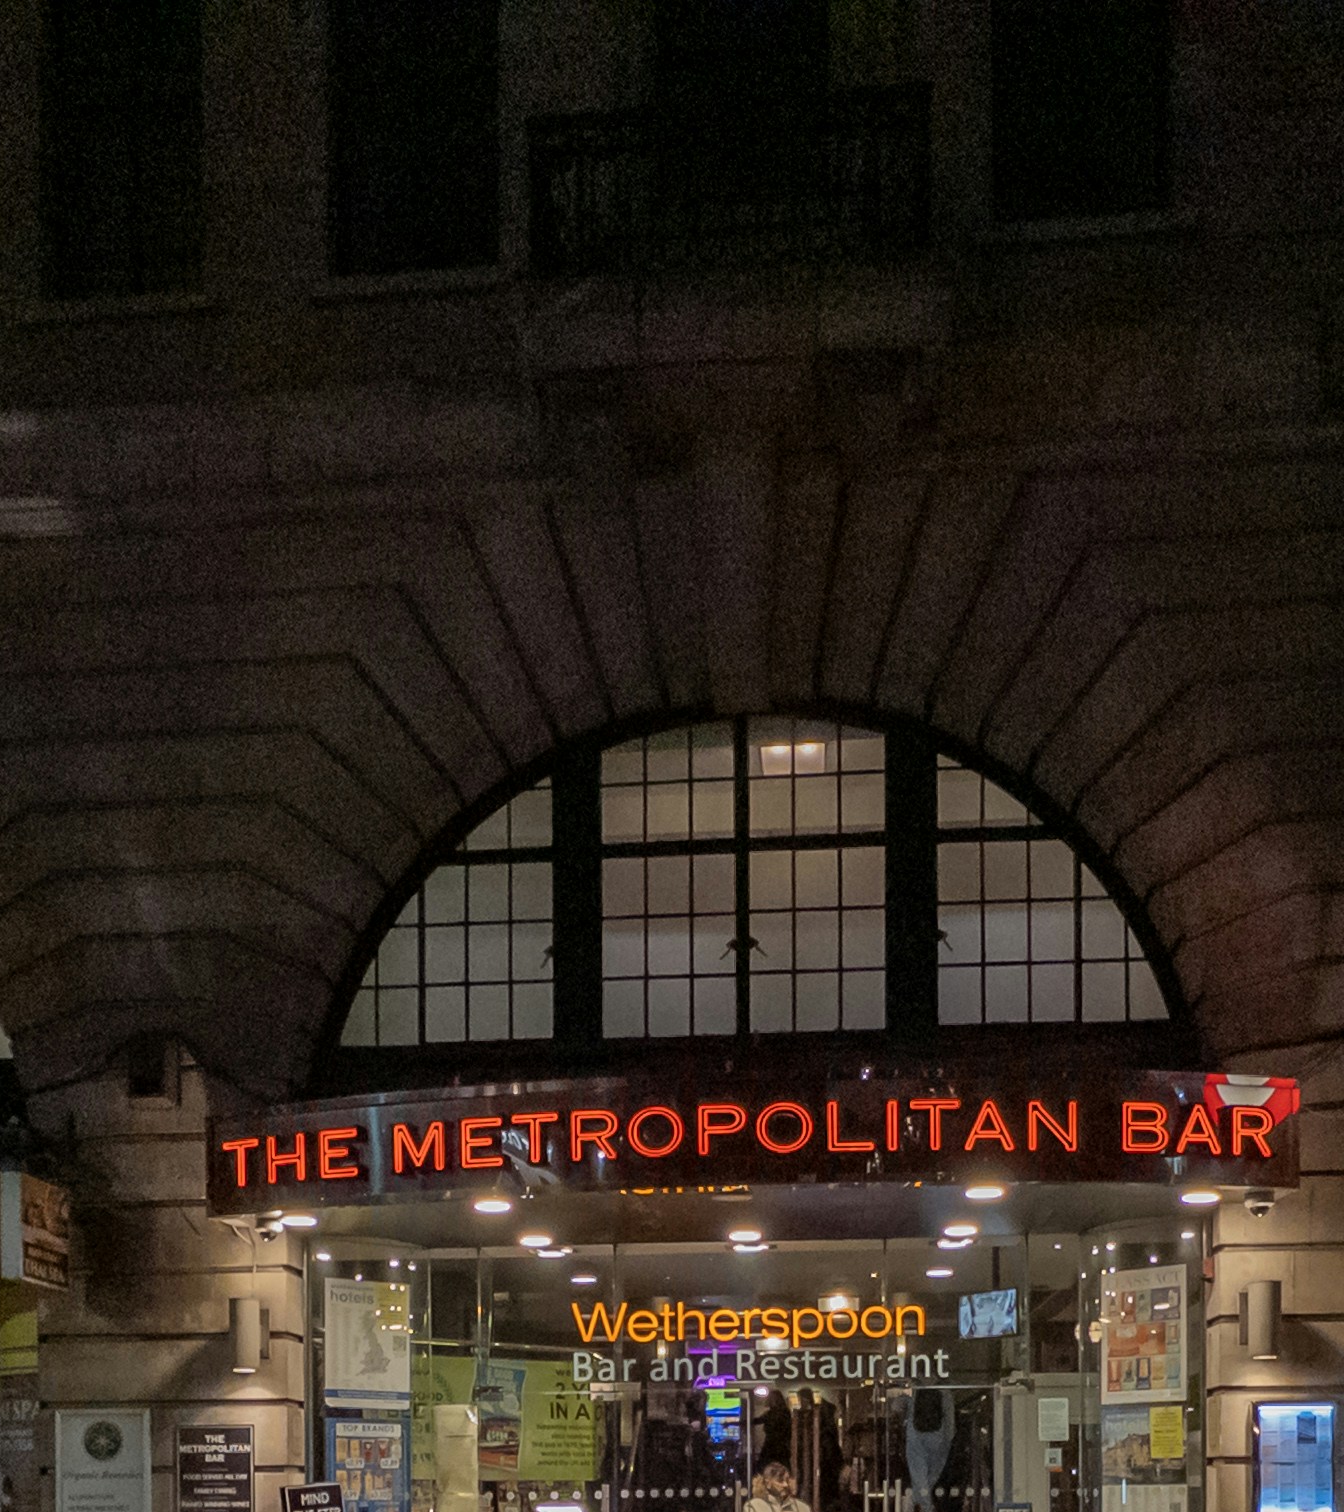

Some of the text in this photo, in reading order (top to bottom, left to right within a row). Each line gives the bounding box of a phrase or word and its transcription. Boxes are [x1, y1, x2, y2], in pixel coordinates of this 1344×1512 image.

[222, 1099, 1274, 1188] THE METROPOLITAN BAR
[571, 1301, 927, 1348] Wetherspoon
[572, 1348, 950, 1382] Bar and Restaurant
[550, 1402, 568, 1419] IN
[575, 1403, 590, 1420] A
[204, 1434, 225, 1443] THE
[180, 1444, 251, 1453] METROPOLITAN
[204, 1454, 225, 1462] BAR
[300, 1492, 330, 1506] MIND
